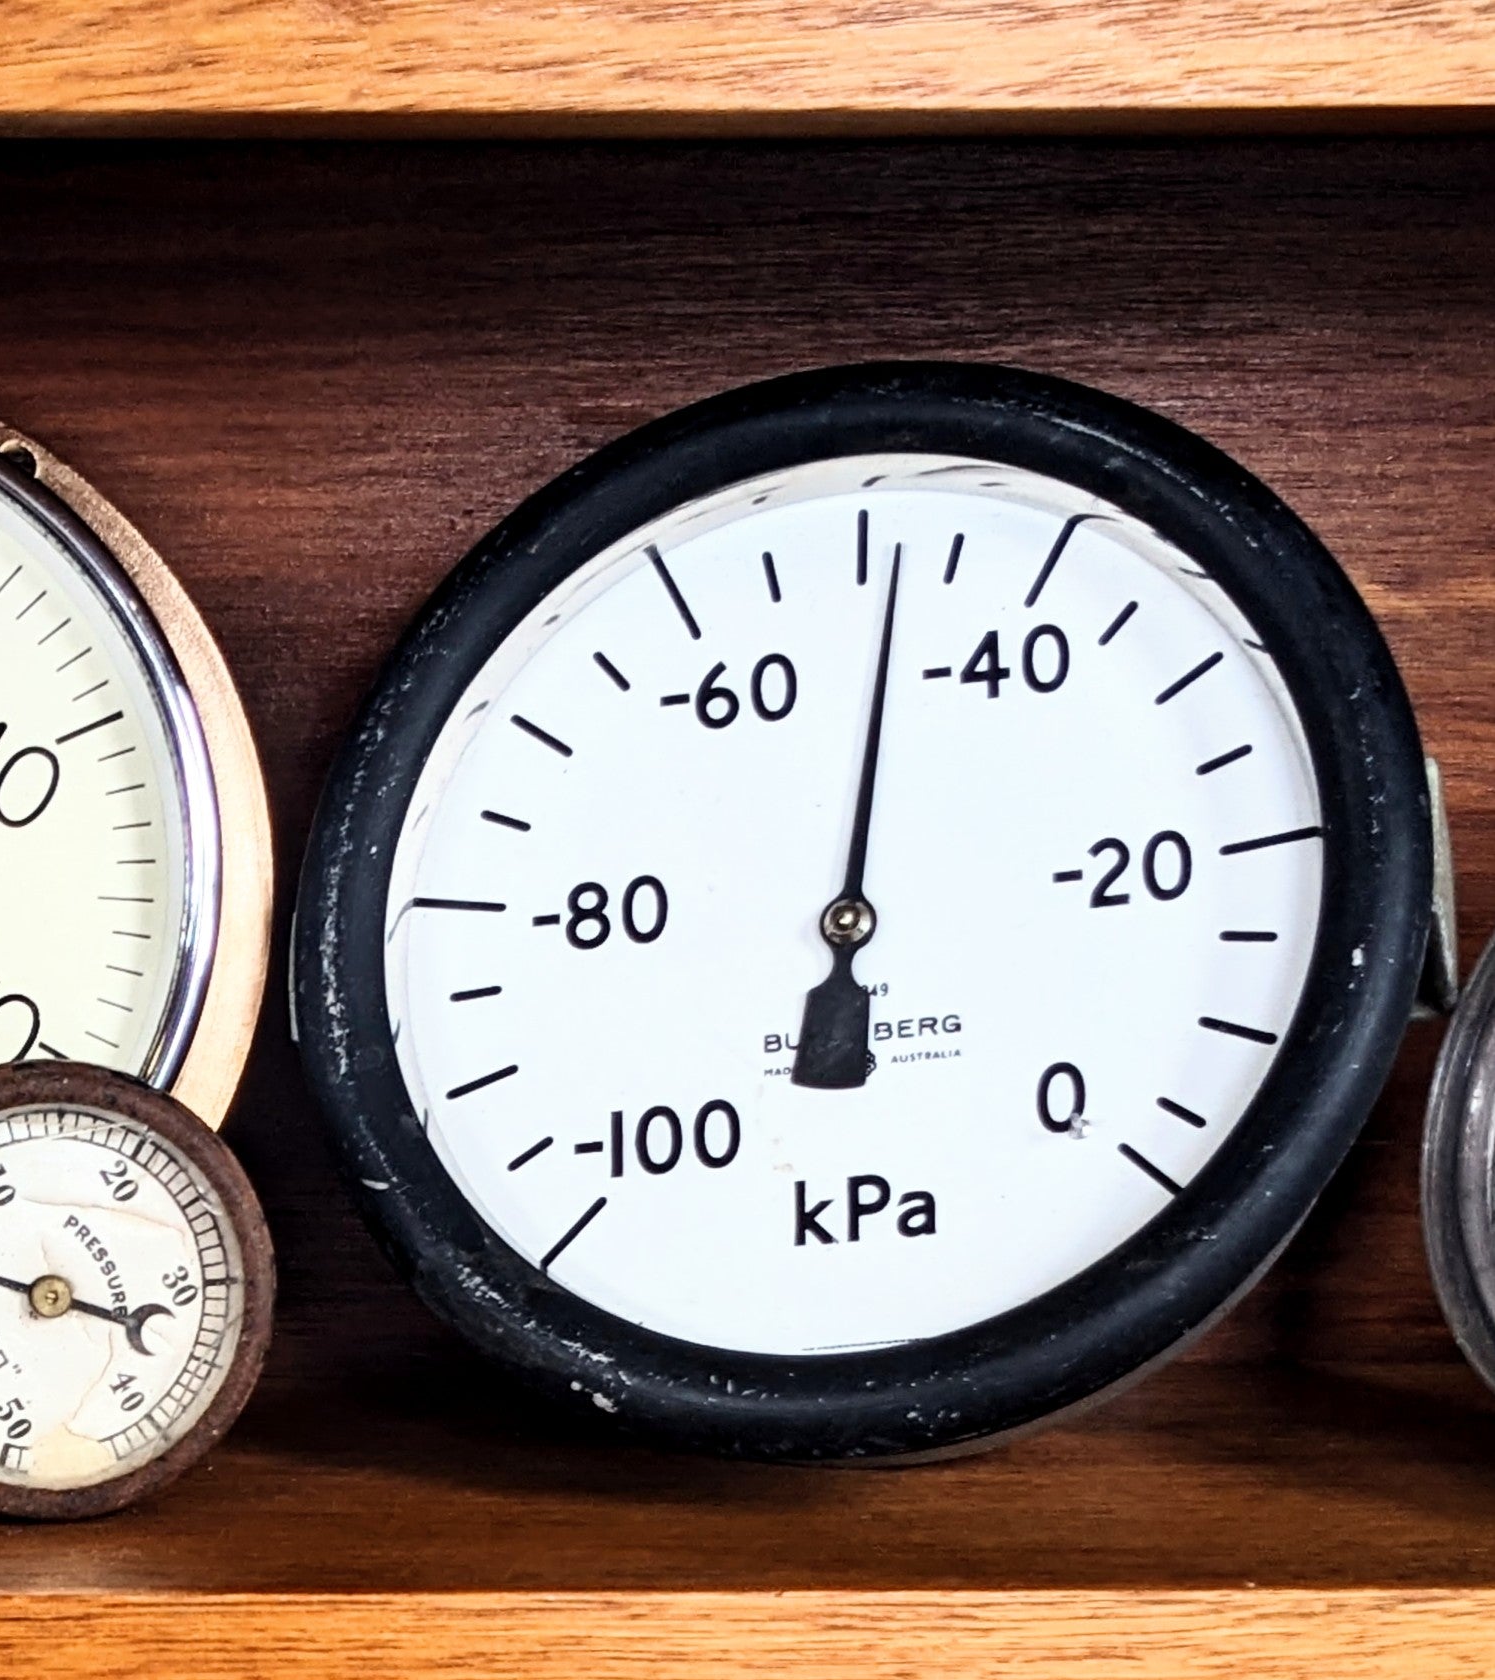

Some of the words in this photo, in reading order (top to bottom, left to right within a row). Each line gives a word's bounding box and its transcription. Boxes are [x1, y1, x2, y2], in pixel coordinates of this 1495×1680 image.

[659, 653, 798, 729] -60
[920, 621, 1072, 699] -40
[1050, 829, 1194, 909] -20
[530, 874, 670, 949] -80
[764, 1014, 962, 1053] BUBERG
[890, 1049, 962, 1064] AUSTRALIA
[1036, 1060, 1087, 1133] 0
[572, 1097, 742, 1178] -100
[99, 1160, 139, 1204] 20
[793, 1174, 939, 1248] kPa
[62, 1214, 127, 1319] PRESSURE
[162, 1265, 199, 1306] 30
[108, 1372, 145, 1413] 40
